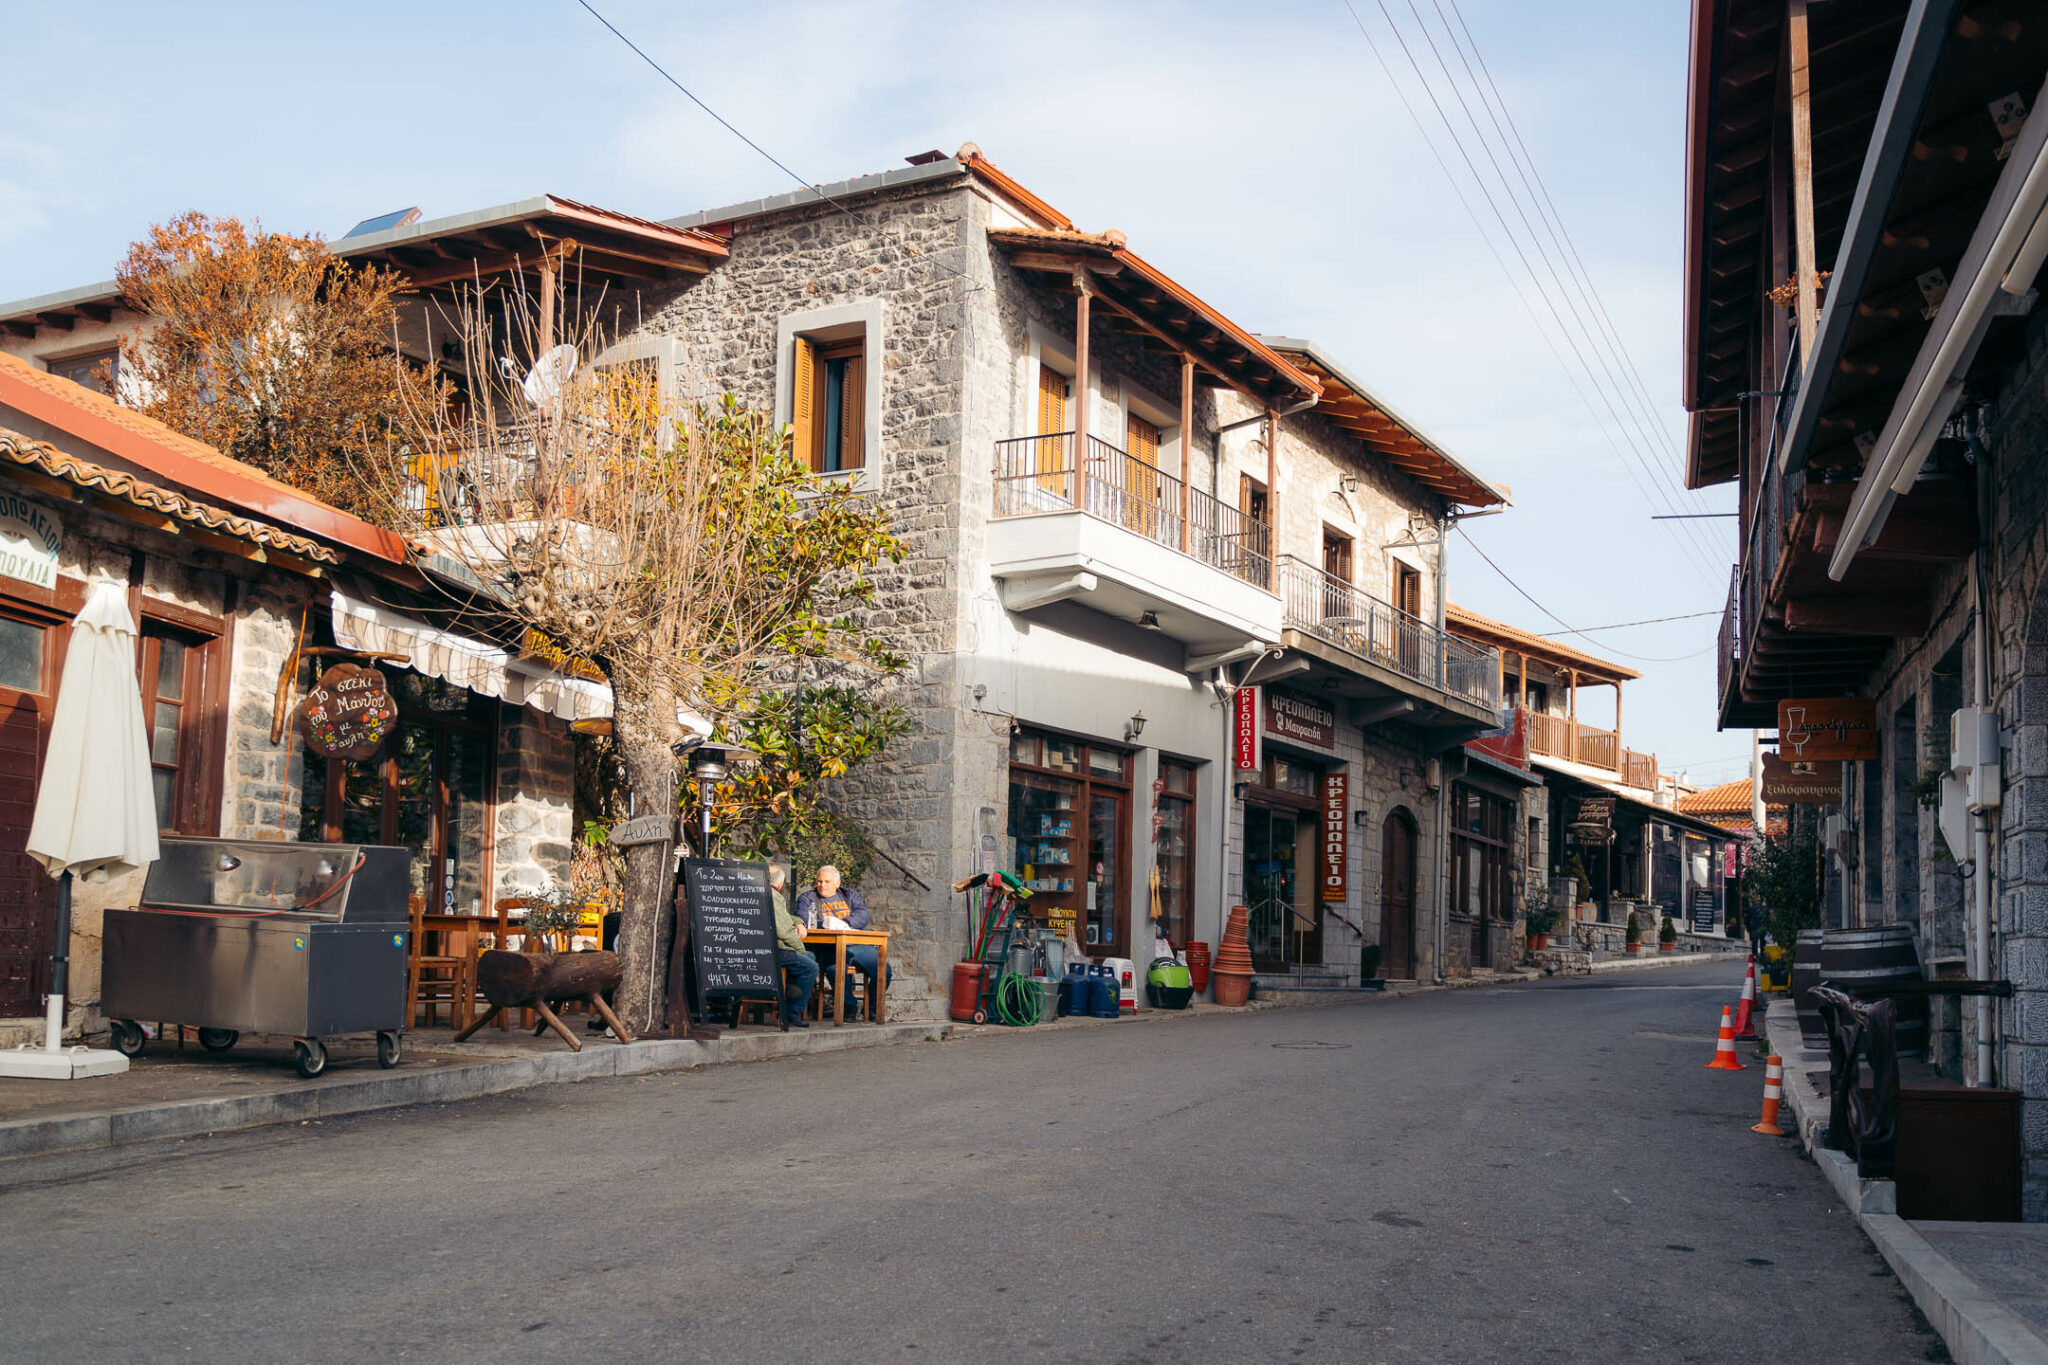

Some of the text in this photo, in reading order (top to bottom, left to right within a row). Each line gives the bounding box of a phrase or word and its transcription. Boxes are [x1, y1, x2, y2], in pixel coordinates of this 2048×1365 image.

[309, 685, 329, 704] Το
[1271, 694, 1333, 727] ΚΡΕΟΠΩΛΕΙΟ
[1240, 689, 1251, 768] ΚΡΕΟΠΩΛΕΙΟ
[622, 820, 662, 841] Αυλή
[1327, 777, 1344, 886] ΚΡΕΟΠΩΛΕΙΟ
